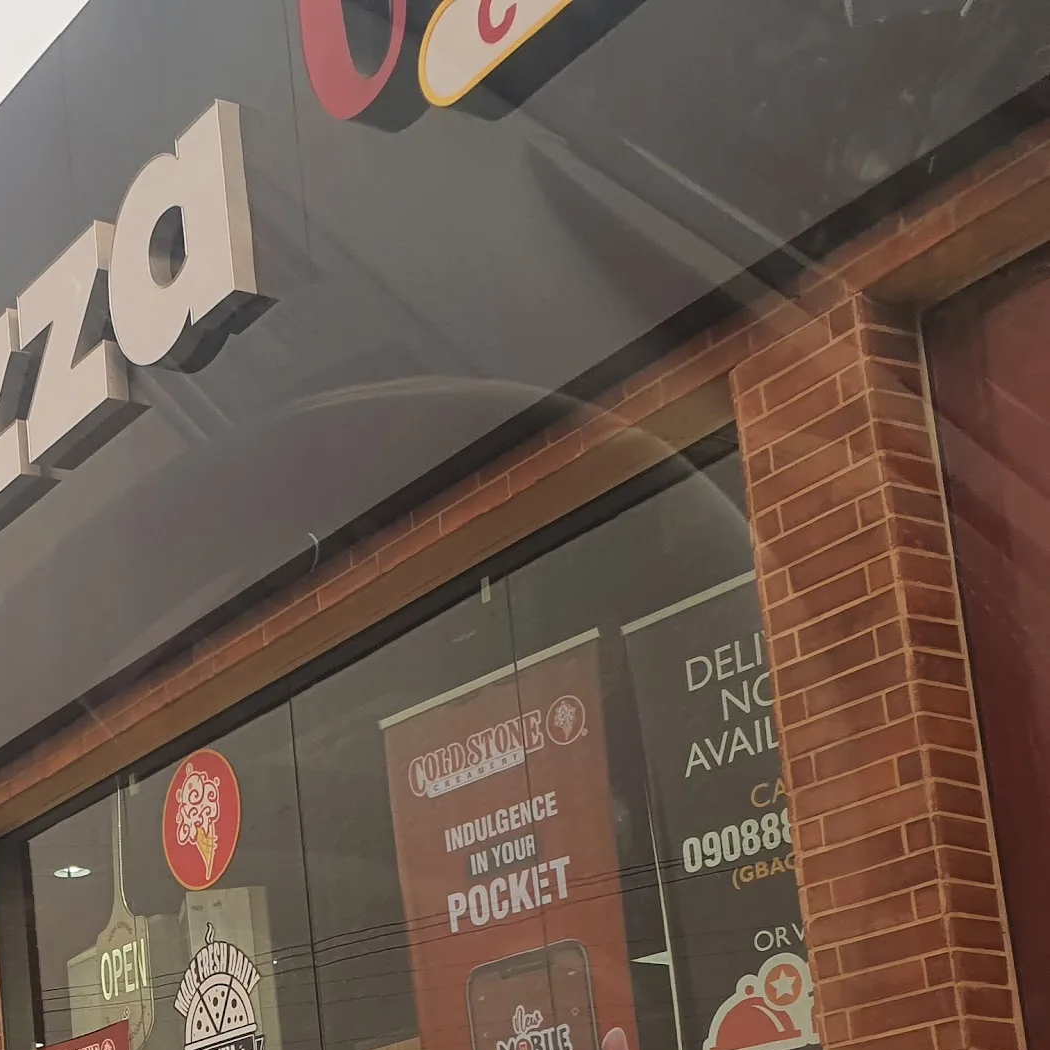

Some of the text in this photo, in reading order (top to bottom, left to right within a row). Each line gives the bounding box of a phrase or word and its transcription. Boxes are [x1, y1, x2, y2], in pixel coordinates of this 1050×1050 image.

[685, 630, 765, 691] DELI
[433, 752, 518, 792] CREAMERY
[444, 791, 558, 852] INDULGENCE
[470, 834, 536, 876] IN YOUR
[447, 856, 570, 933] POCKET
[101, 938, 147, 1000] OPEN
[754, 926, 792, 951] OR
[174, 941, 261, 1017] MADE FRESH DAILY
